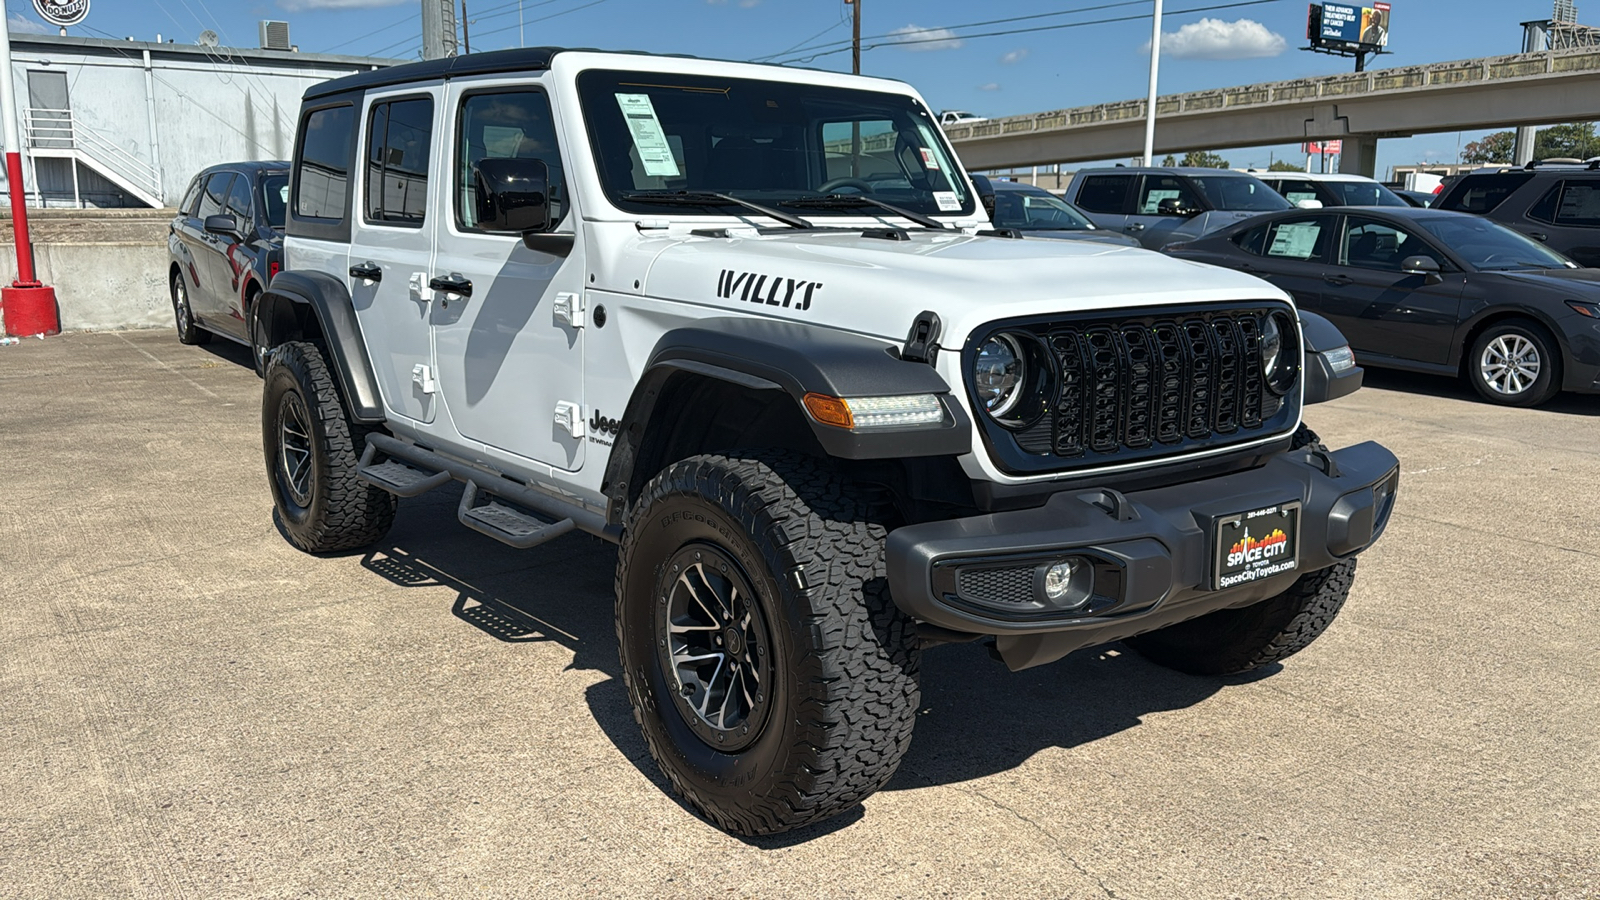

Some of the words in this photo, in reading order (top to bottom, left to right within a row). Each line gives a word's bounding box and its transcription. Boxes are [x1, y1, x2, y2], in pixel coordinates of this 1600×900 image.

[716, 269, 823, 311] WILLYS
[589, 408, 621, 435] Jee
[1227, 546, 1262, 567] SPACE
[1263, 540, 1286, 558] CITY
[1252, 559, 1269, 568] TOYOTA
[1220, 560, 1294, 587] SpaceCityToyota.com
